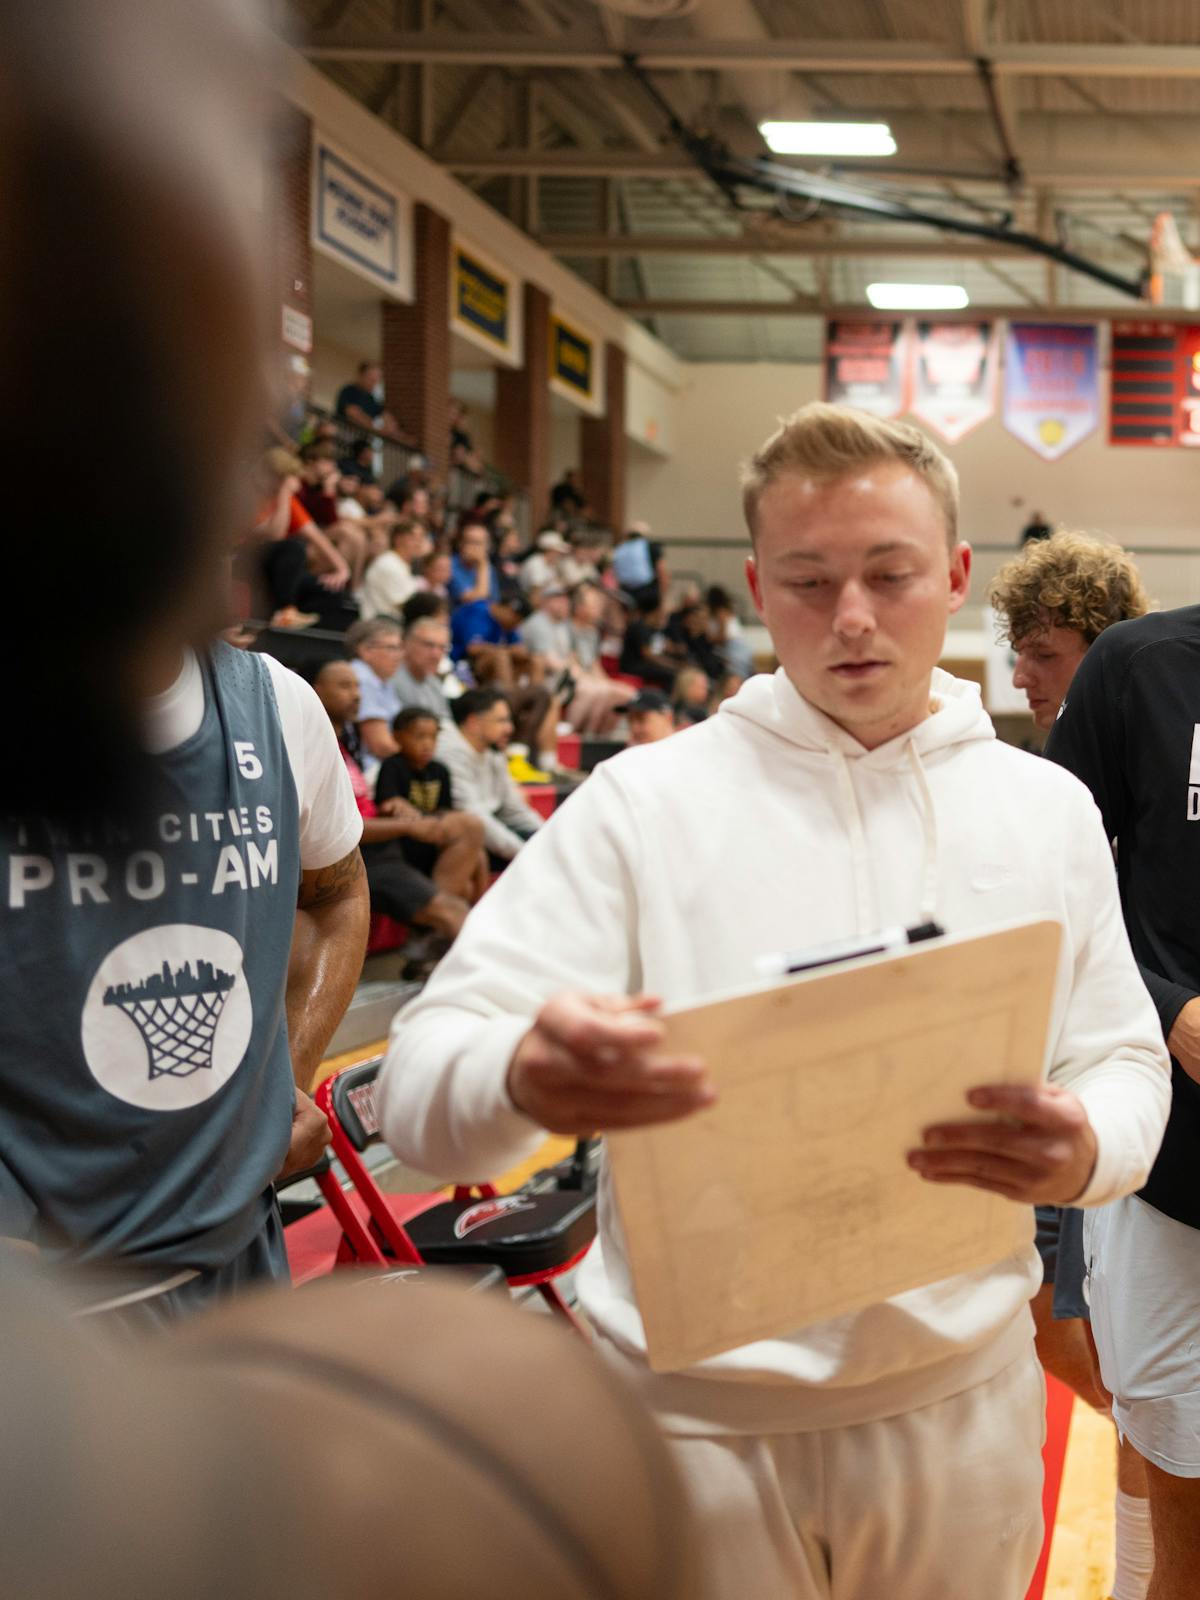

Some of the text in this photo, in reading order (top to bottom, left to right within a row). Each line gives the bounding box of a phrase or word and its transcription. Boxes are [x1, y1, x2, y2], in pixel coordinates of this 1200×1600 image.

[233, 741, 264, 780] 5
[158, 805, 274, 843] CITIES
[8, 839, 279, 909] PRO-AM
